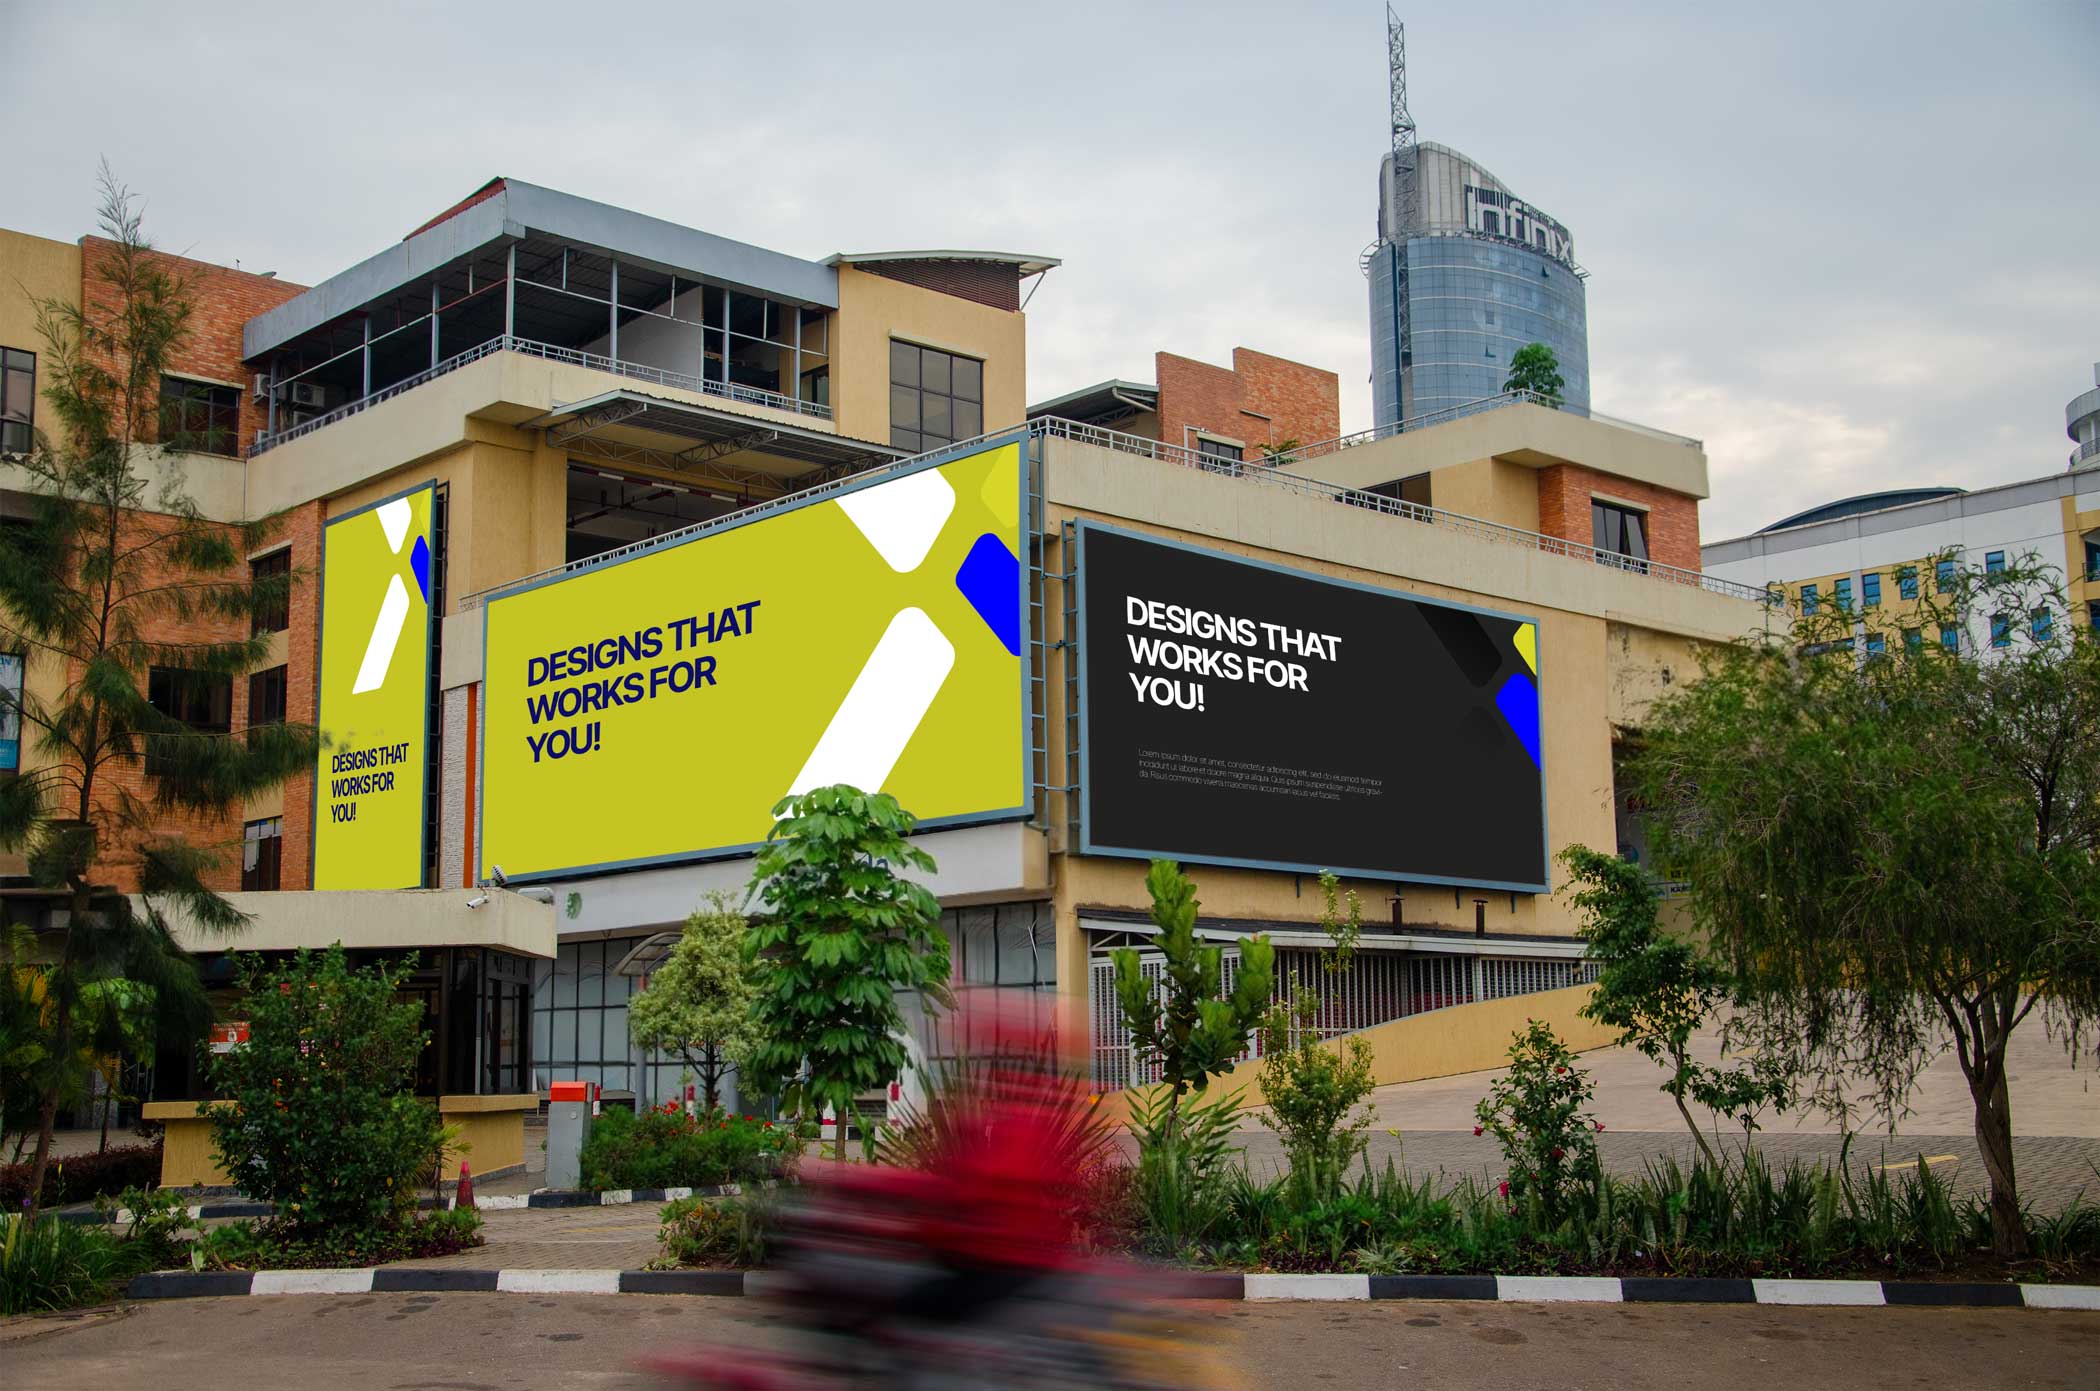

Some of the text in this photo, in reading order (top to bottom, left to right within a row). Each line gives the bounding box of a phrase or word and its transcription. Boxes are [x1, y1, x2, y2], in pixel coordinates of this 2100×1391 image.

[527, 600, 761, 688] DESIGNS THAT
[1126, 595, 1342, 662] DESIGNS THAT
[1126, 634, 1310, 692] WORKS FOR
[526, 655, 717, 725] WORKS FOR
[1128, 672, 1205, 712] YOU!
[332, 742, 409, 774] DESIGNS THAT
[526, 721, 601, 763] YOU!
[331, 771, 395, 798] WORKS FOR
[331, 802, 357, 823] YOU!
